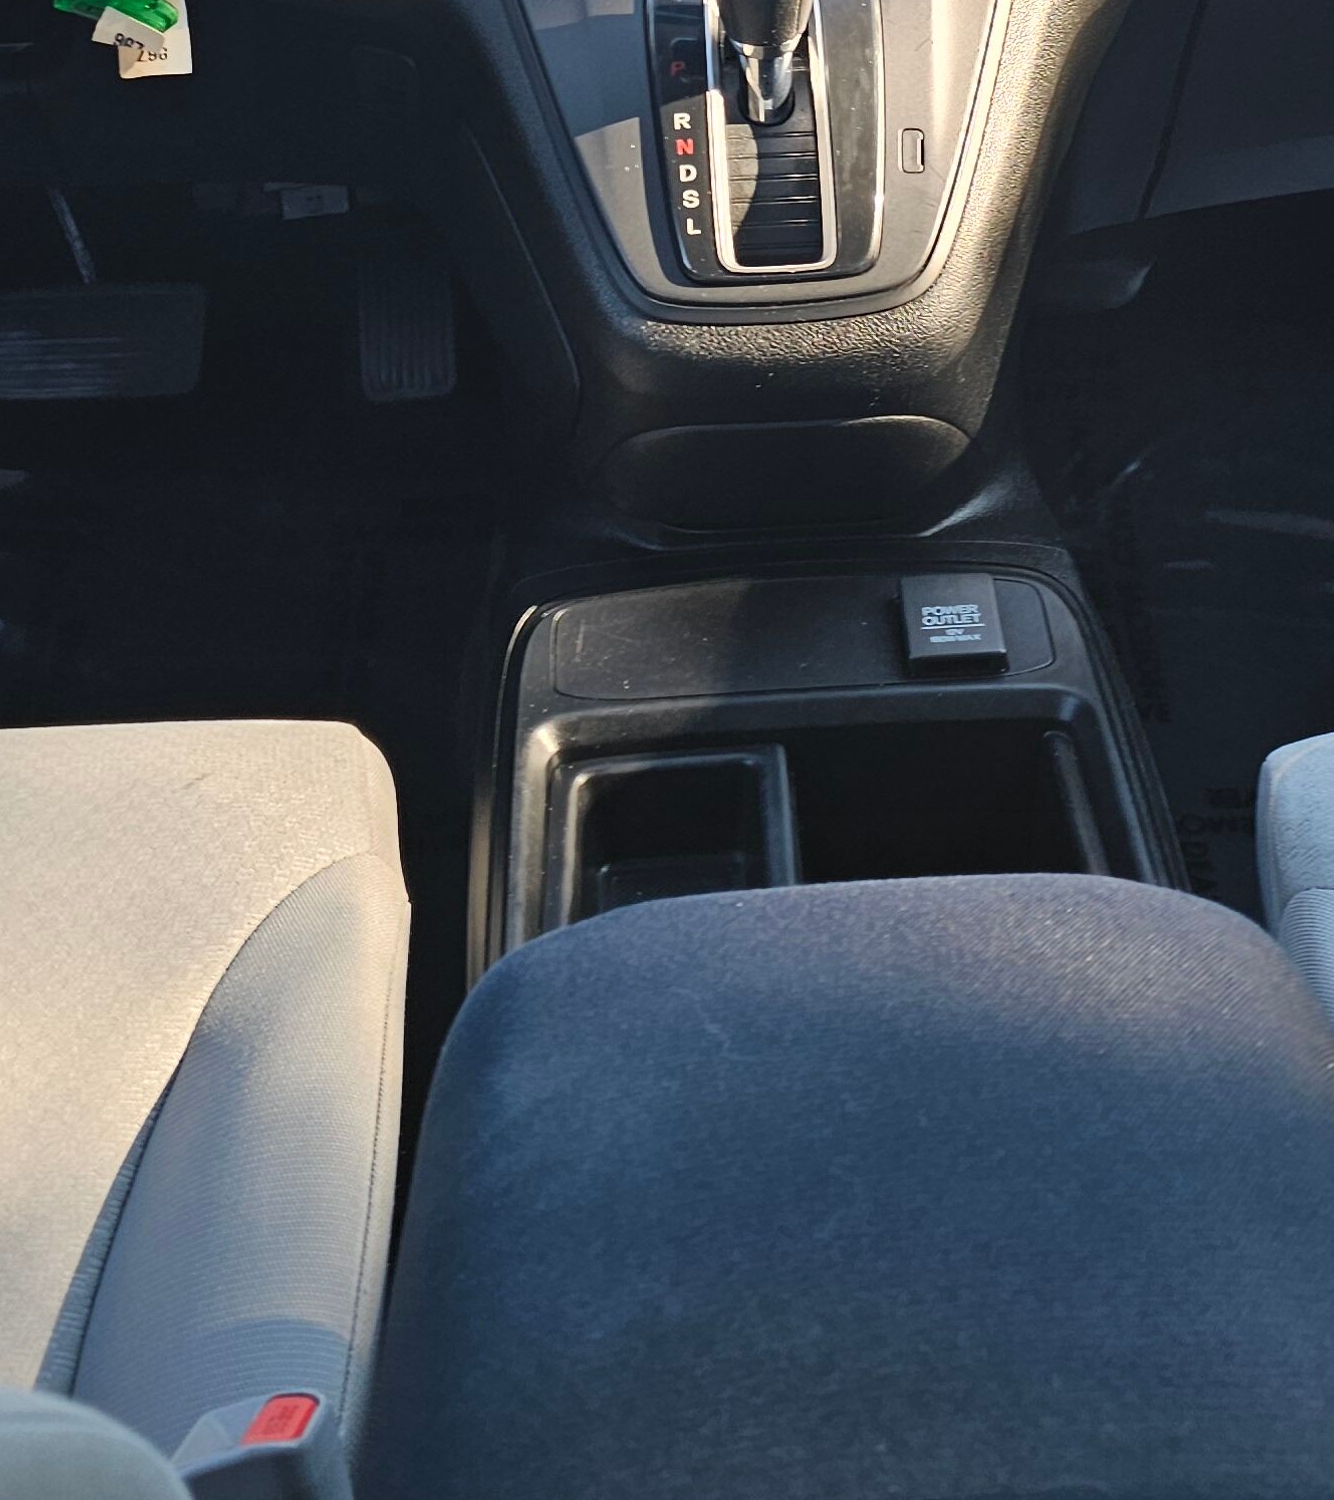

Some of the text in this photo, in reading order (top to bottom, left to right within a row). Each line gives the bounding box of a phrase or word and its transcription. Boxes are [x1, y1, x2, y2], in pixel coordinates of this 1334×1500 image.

[670, 61, 685, 77] P
[673, 112, 691, 130] R
[676, 138, 694, 155] N
[679, 164, 698, 183] D
[682, 189, 700, 208] S
[686, 218, 702, 236] L
[922, 604, 978, 616] POWER
[922, 613, 981, 626] OUTLET
